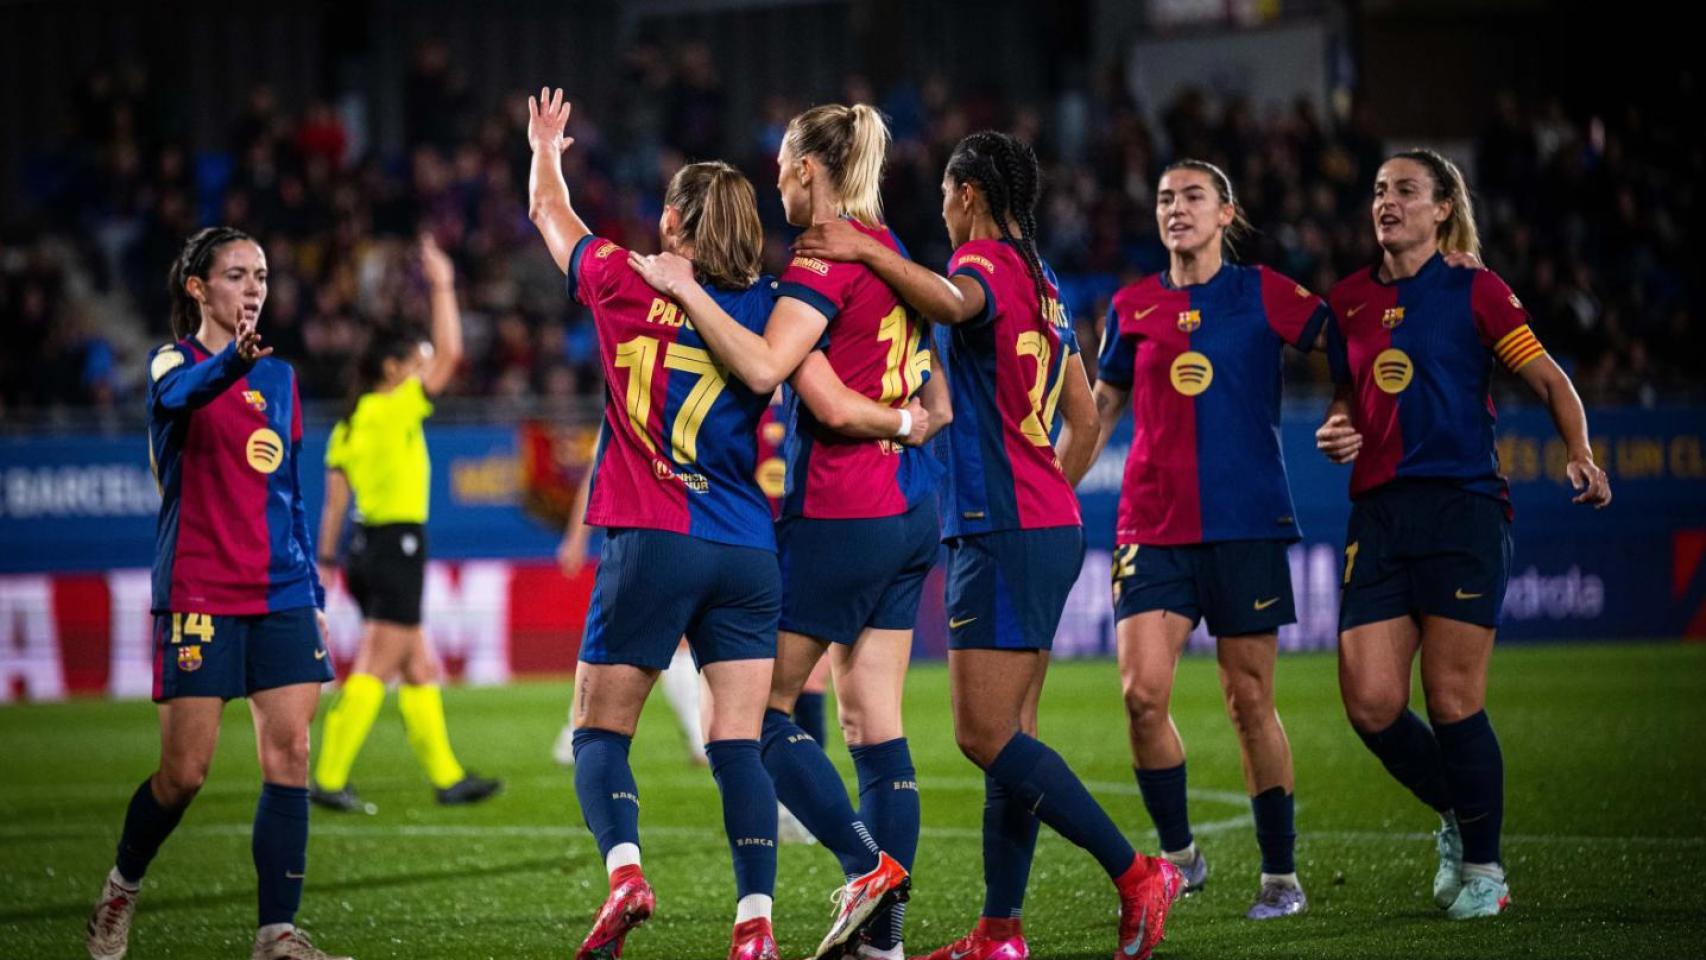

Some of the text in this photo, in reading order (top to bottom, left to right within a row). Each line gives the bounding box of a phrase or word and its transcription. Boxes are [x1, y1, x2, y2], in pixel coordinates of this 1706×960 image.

[646, 297, 696, 331] PAJ
[614, 335, 729, 464] 17
[171, 612, 215, 643] 14
